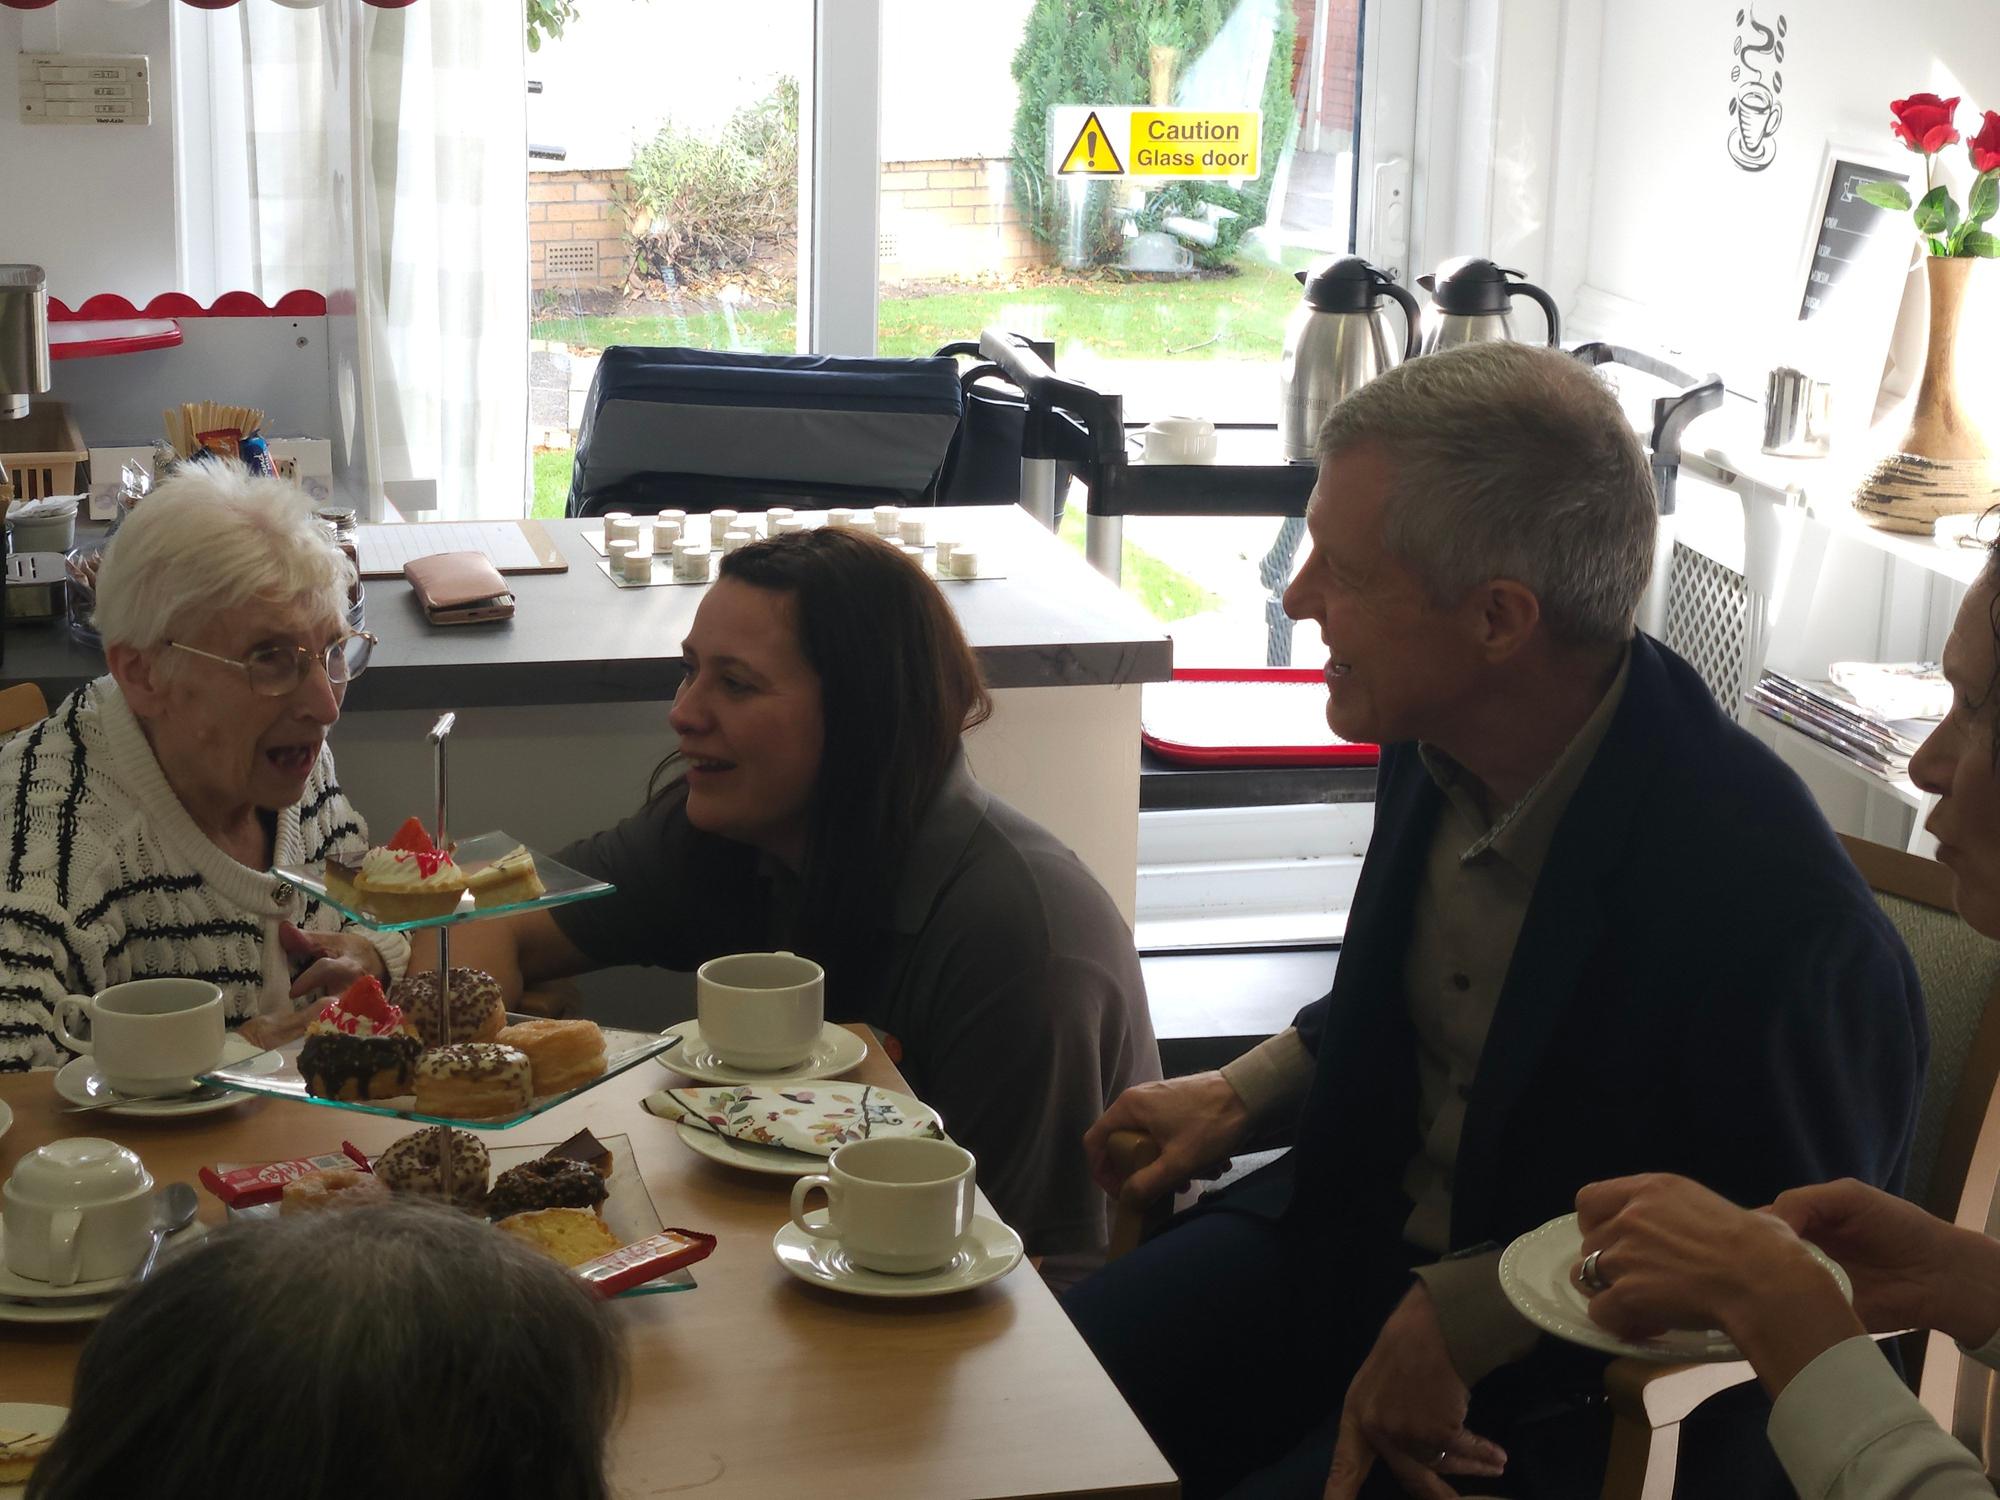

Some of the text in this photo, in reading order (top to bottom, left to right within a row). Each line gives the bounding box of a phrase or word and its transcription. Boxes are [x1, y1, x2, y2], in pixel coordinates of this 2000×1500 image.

[1148, 120, 1239, 140] Caution
[1137, 149, 1249, 166] Glass door
